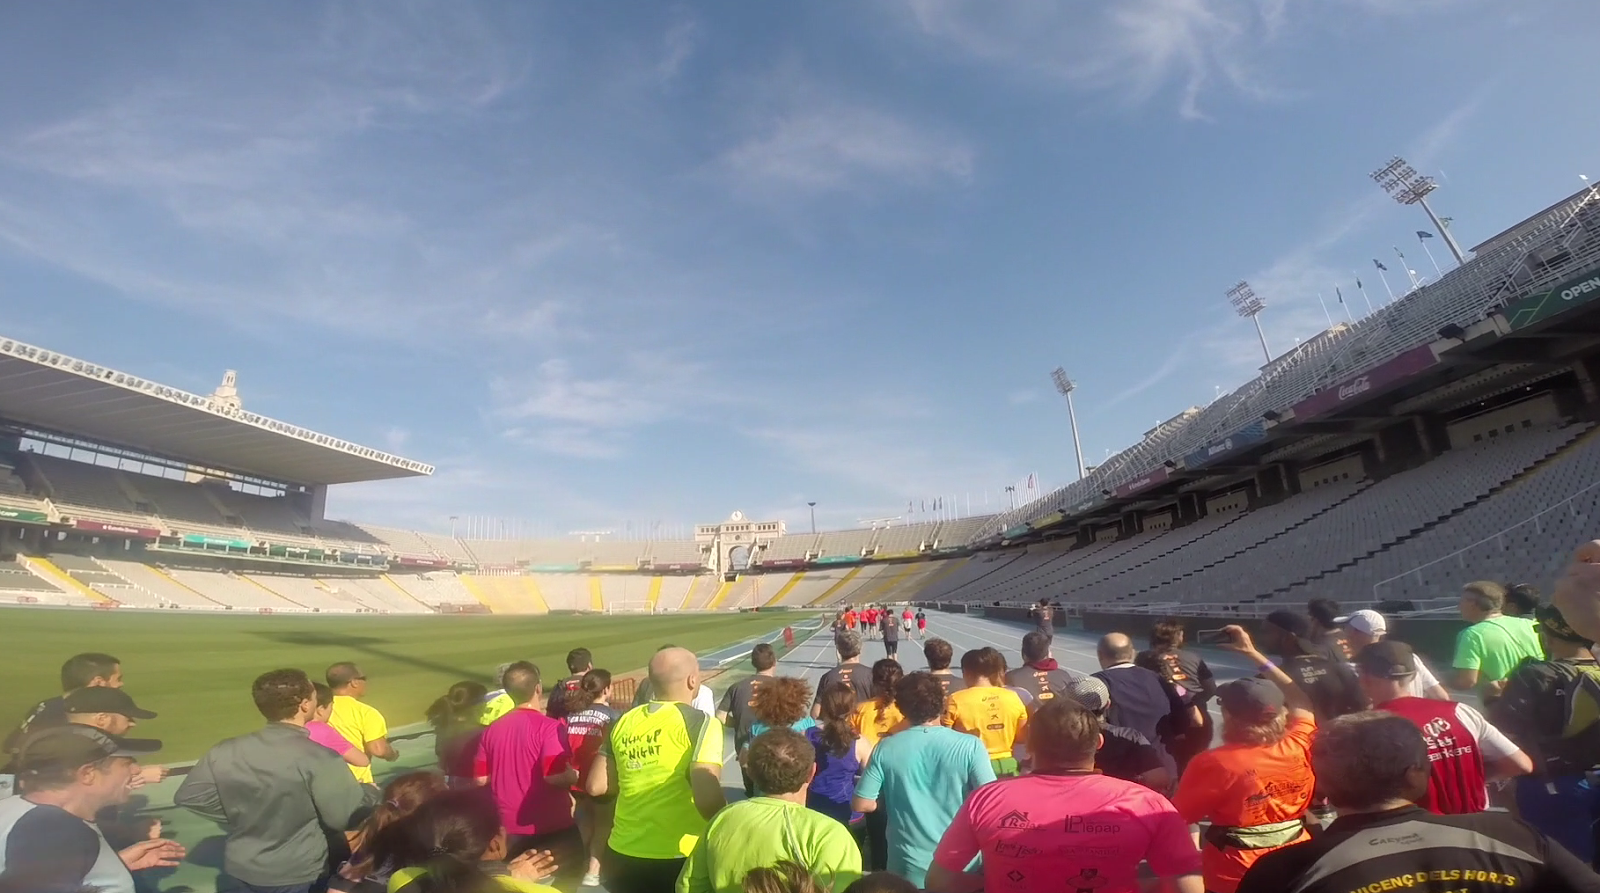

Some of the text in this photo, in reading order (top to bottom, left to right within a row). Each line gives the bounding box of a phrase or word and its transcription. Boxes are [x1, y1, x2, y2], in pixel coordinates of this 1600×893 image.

[1561, 276, 1600, 300] OPEN
[1416, 870, 1460, 883] DELS
[1464, 869, 1517, 886] HORTS
